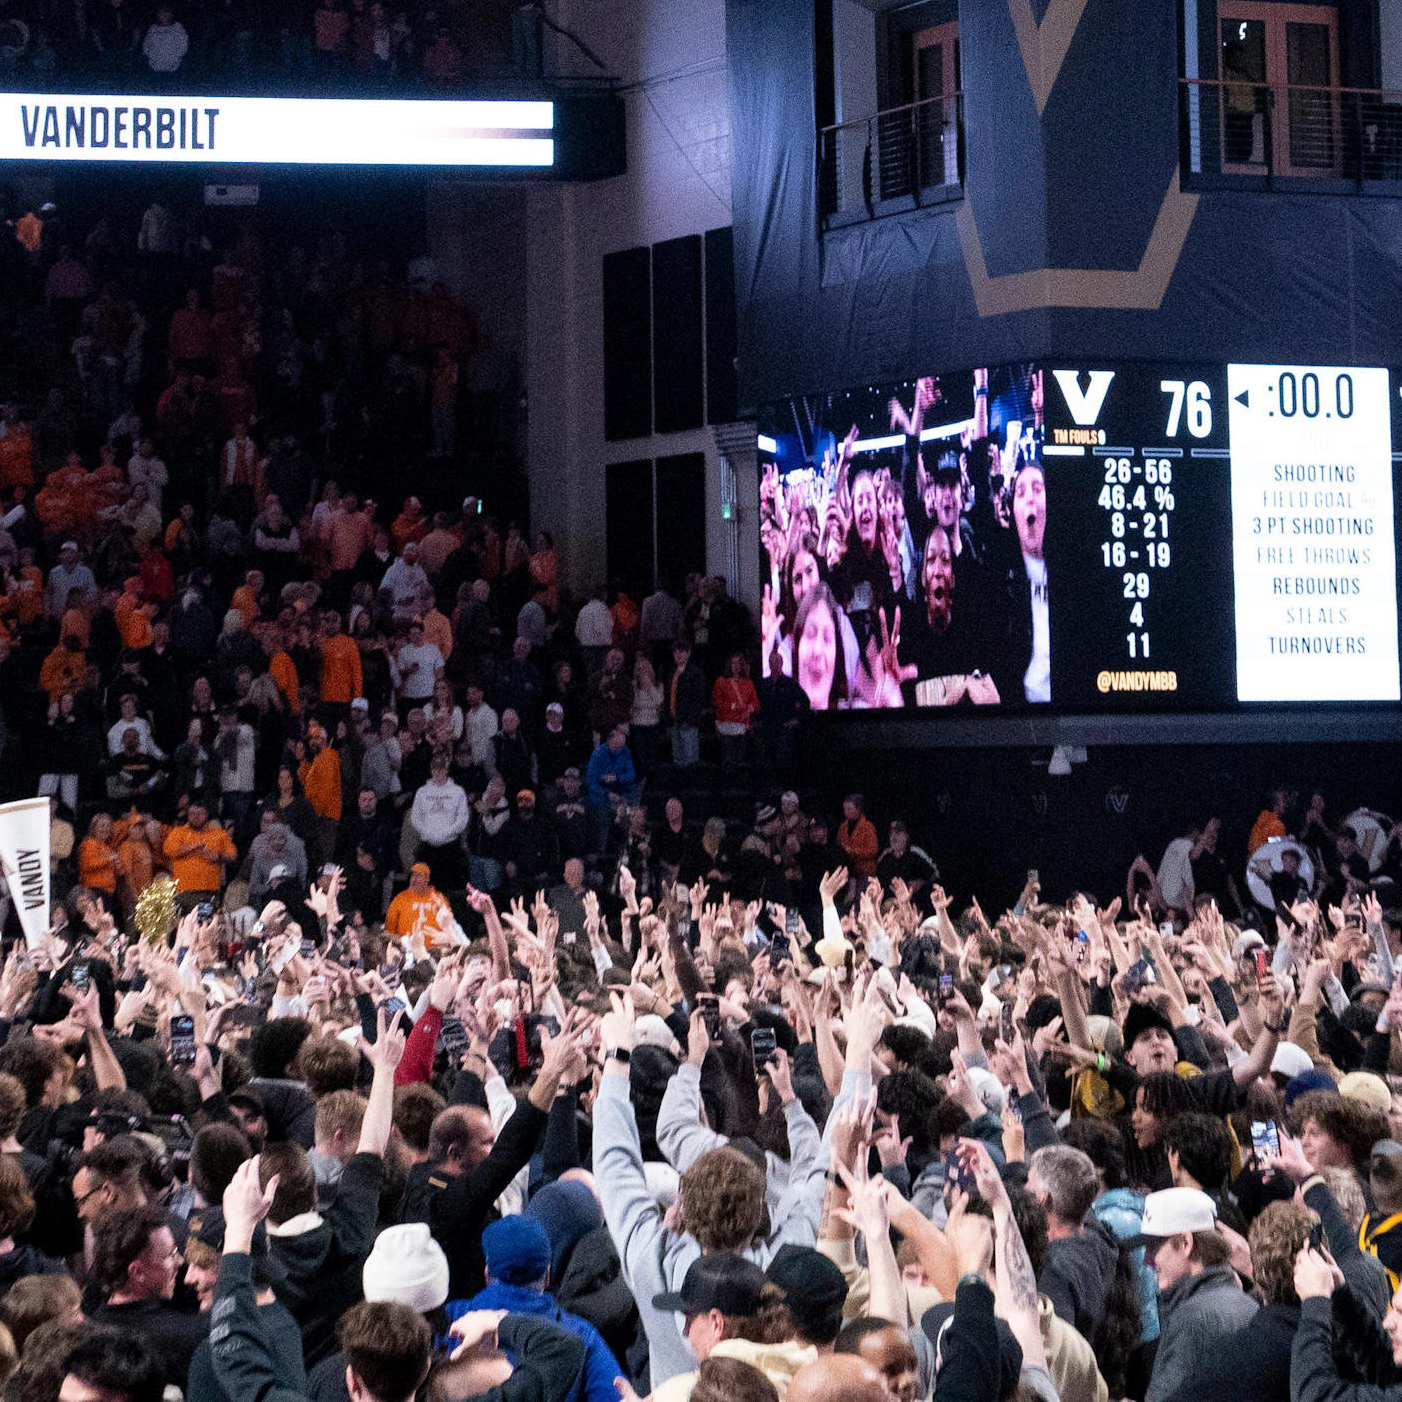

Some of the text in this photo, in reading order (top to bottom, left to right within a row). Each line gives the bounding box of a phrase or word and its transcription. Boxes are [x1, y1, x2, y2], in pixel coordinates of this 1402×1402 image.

[20, 104, 220, 150] VANDERBILT
[1052, 369, 1116, 426] V
[1160, 380, 1213, 438] 76
[1069, 429, 1097, 445] FOULS
[1273, 464, 1355, 483] SHOOTING
[1098, 484, 1175, 511] 46.4 %
[1263, 490, 1308, 508] FIELD
[1314, 491, 1352, 509] GOAL
[1253, 517, 1374, 536] 3 PT SHOOTING
[1256, 547, 1371, 565] FREE THROWS
[1123, 572, 1150, 598] 29
[1273, 577, 1361, 595] REBOUNDS
[1129, 601, 1144, 628] 4
[1286, 607, 1347, 624] STEALS
[1126, 632, 1150, 658] 11
[1269, 636, 1366, 654] TURNOVERS
[1097, 670, 1178, 693] @VANDYMBB
[16, 848, 46, 911] VANDY
